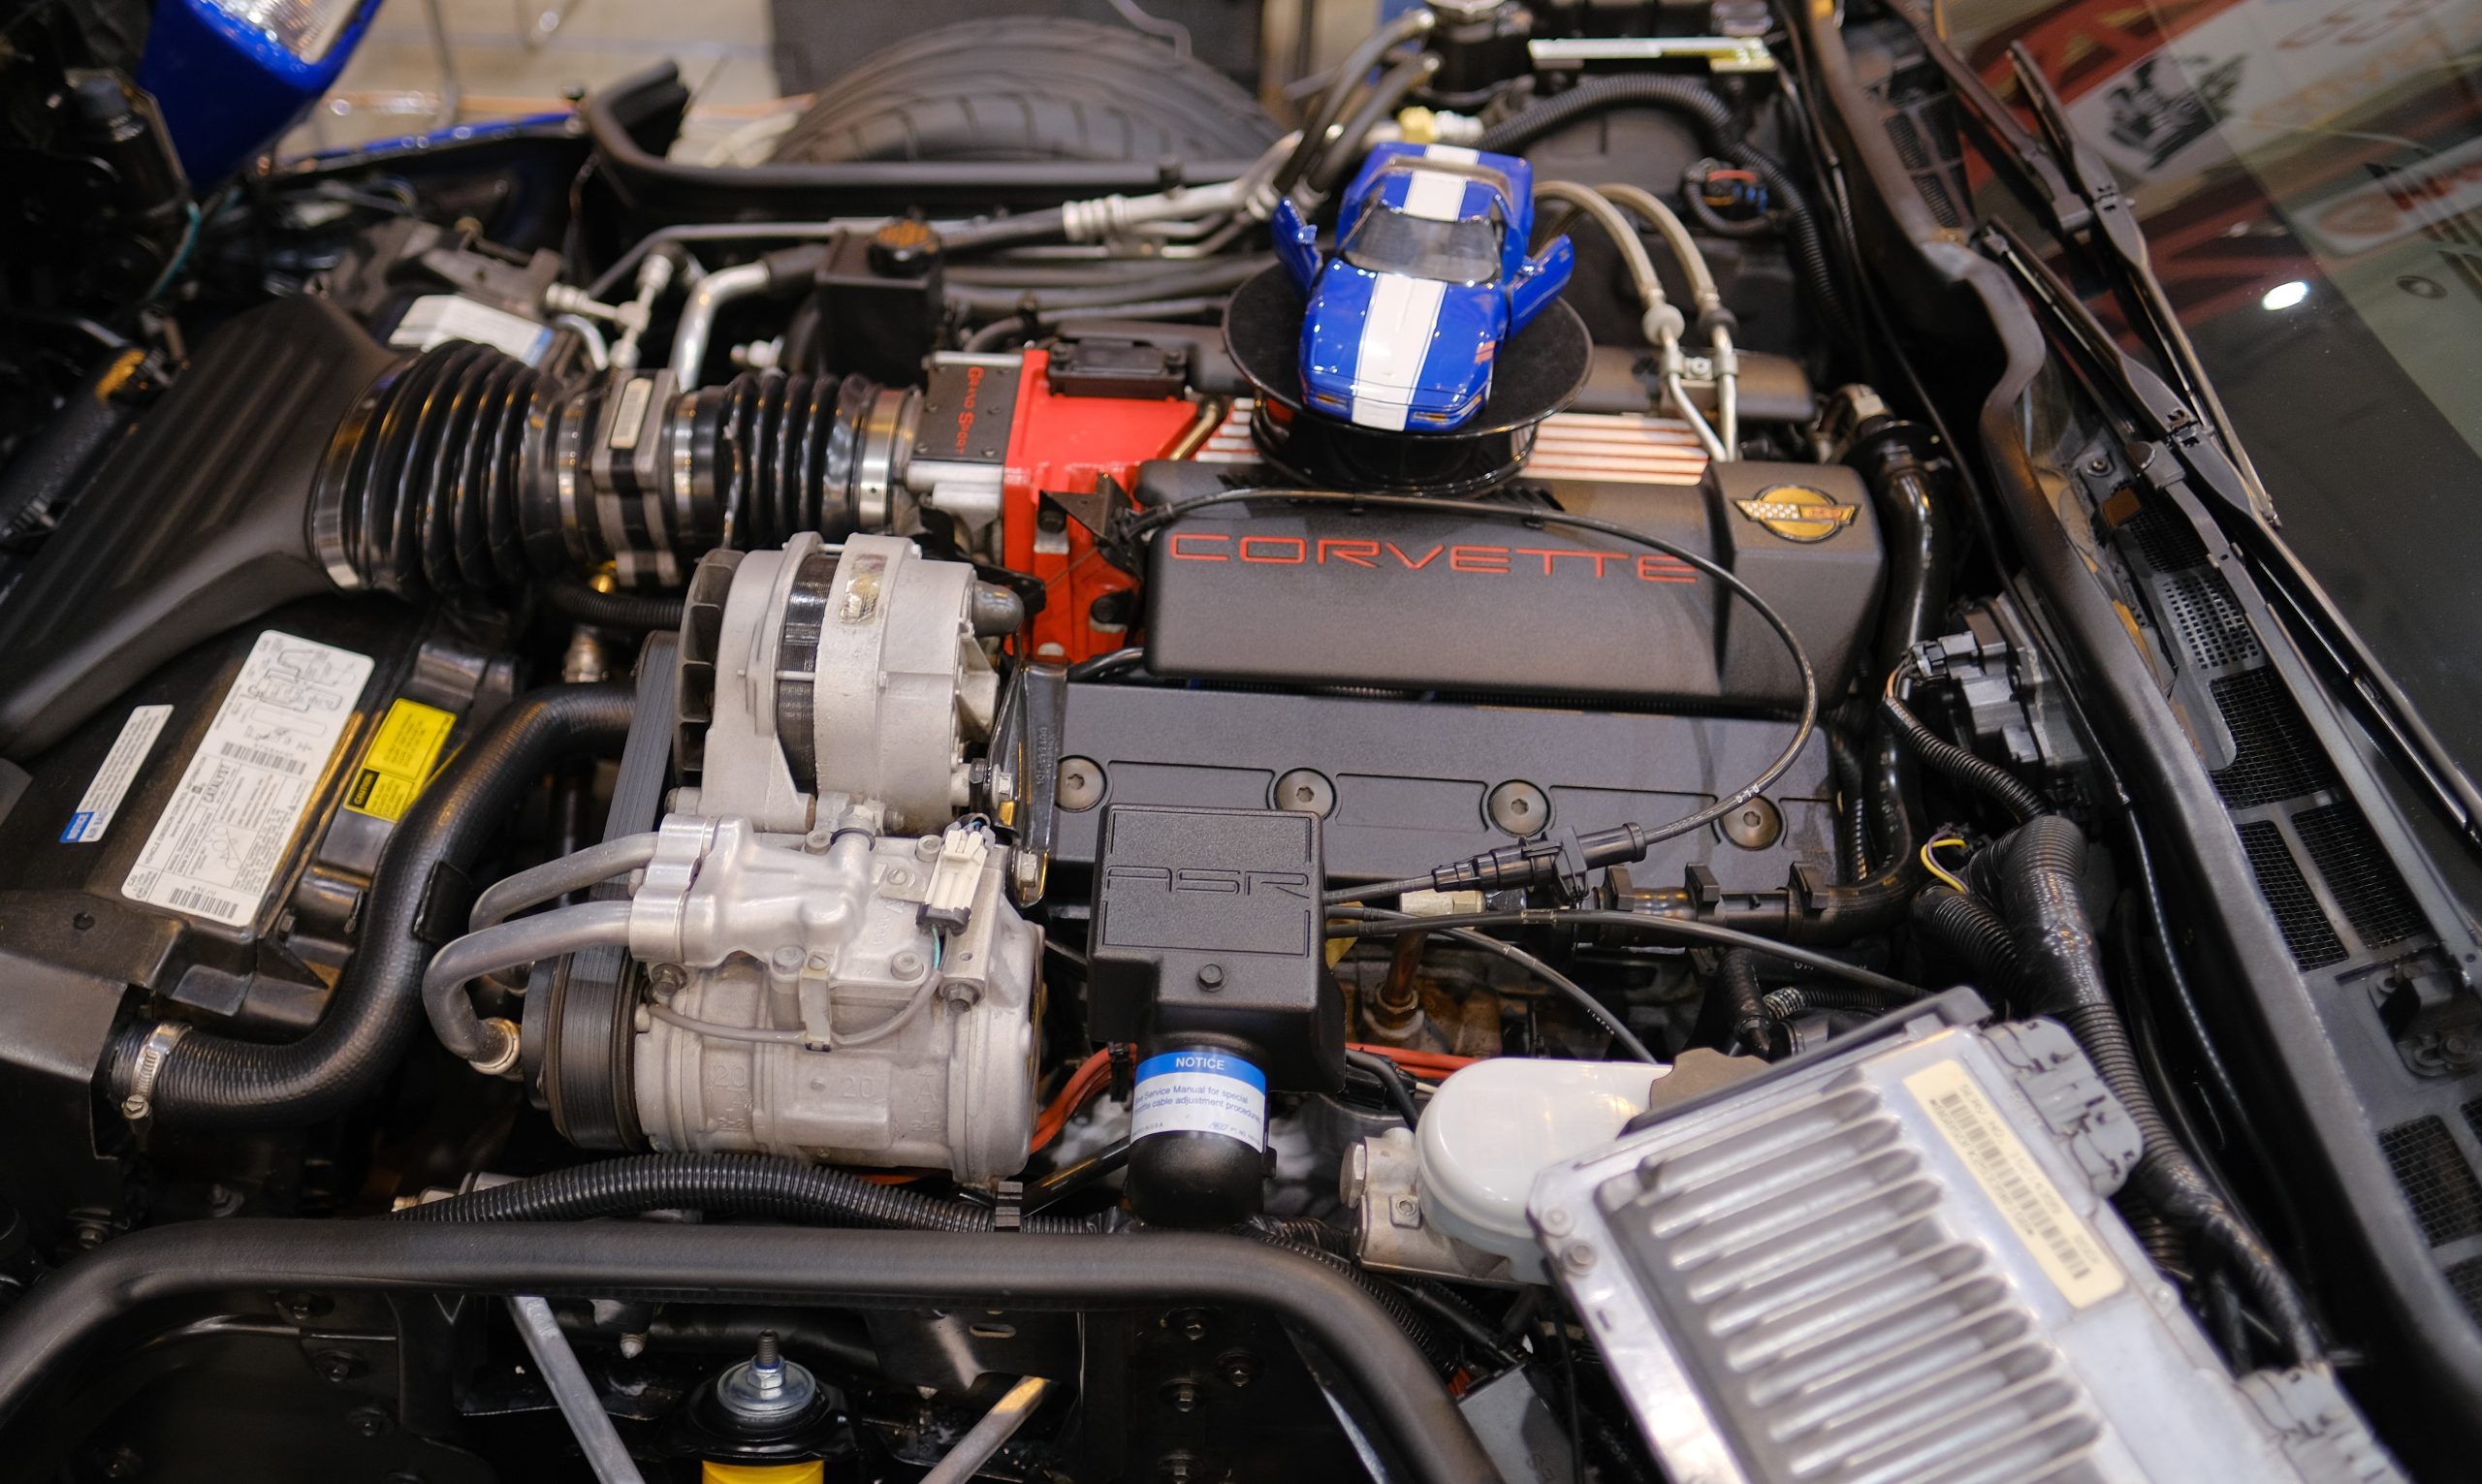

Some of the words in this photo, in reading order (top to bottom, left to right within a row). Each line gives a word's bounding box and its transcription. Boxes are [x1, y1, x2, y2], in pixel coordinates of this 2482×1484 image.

[955, 411, 974, 455] SPORT
[1169, 532, 1699, 583] CORVETTE
[202, 763, 231, 803] CATALYST
[1105, 866, 1310, 900] ASR
[1175, 1057, 1225, 1071] NOTICE
[843, 1077, 874, 1098] 20
[1144, 1086, 1170, 1100] Service
[1172, 1085, 1206, 1094] Manual
[1208, 1086, 1220, 1095] for
[1222, 1089, 1249, 1104] special
[1152, 1096, 1173, 1109] cable
[1175, 1095, 1224, 1107] adjustment
